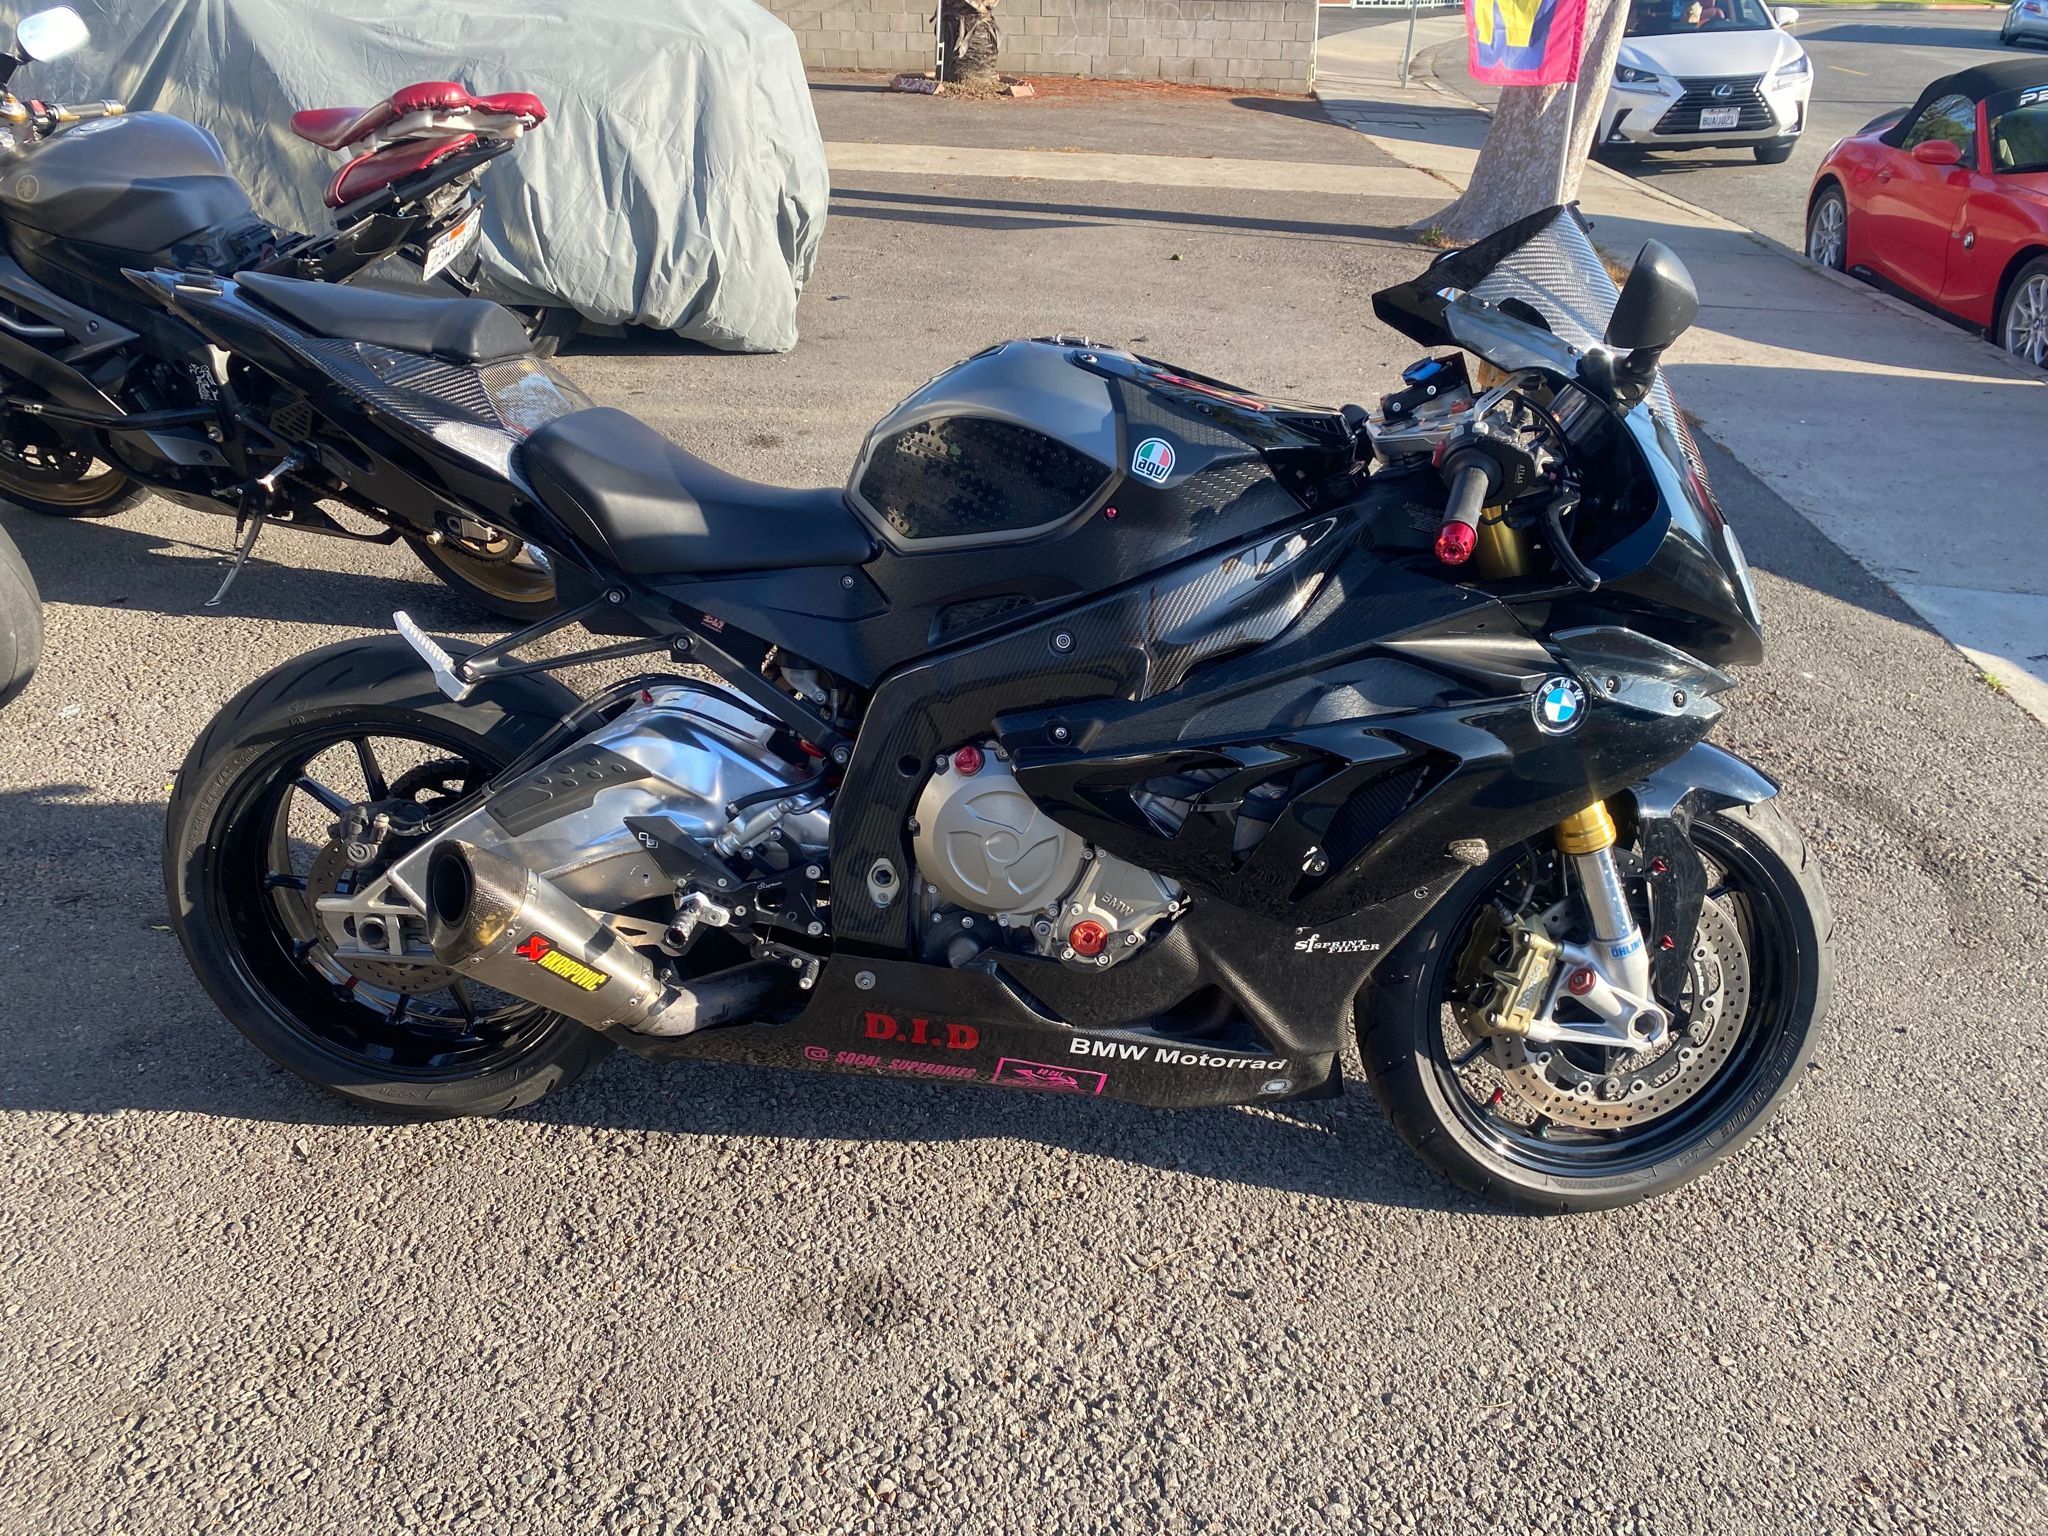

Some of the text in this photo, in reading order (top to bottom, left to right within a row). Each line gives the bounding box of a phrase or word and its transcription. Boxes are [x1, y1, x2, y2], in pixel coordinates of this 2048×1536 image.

[1543, 679, 1585, 701] BMW
[1101, 891, 1134, 917] BMW
[864, 1012, 979, 1050] D.I.D
[1069, 1037, 1288, 1070] BMW Motorrad
